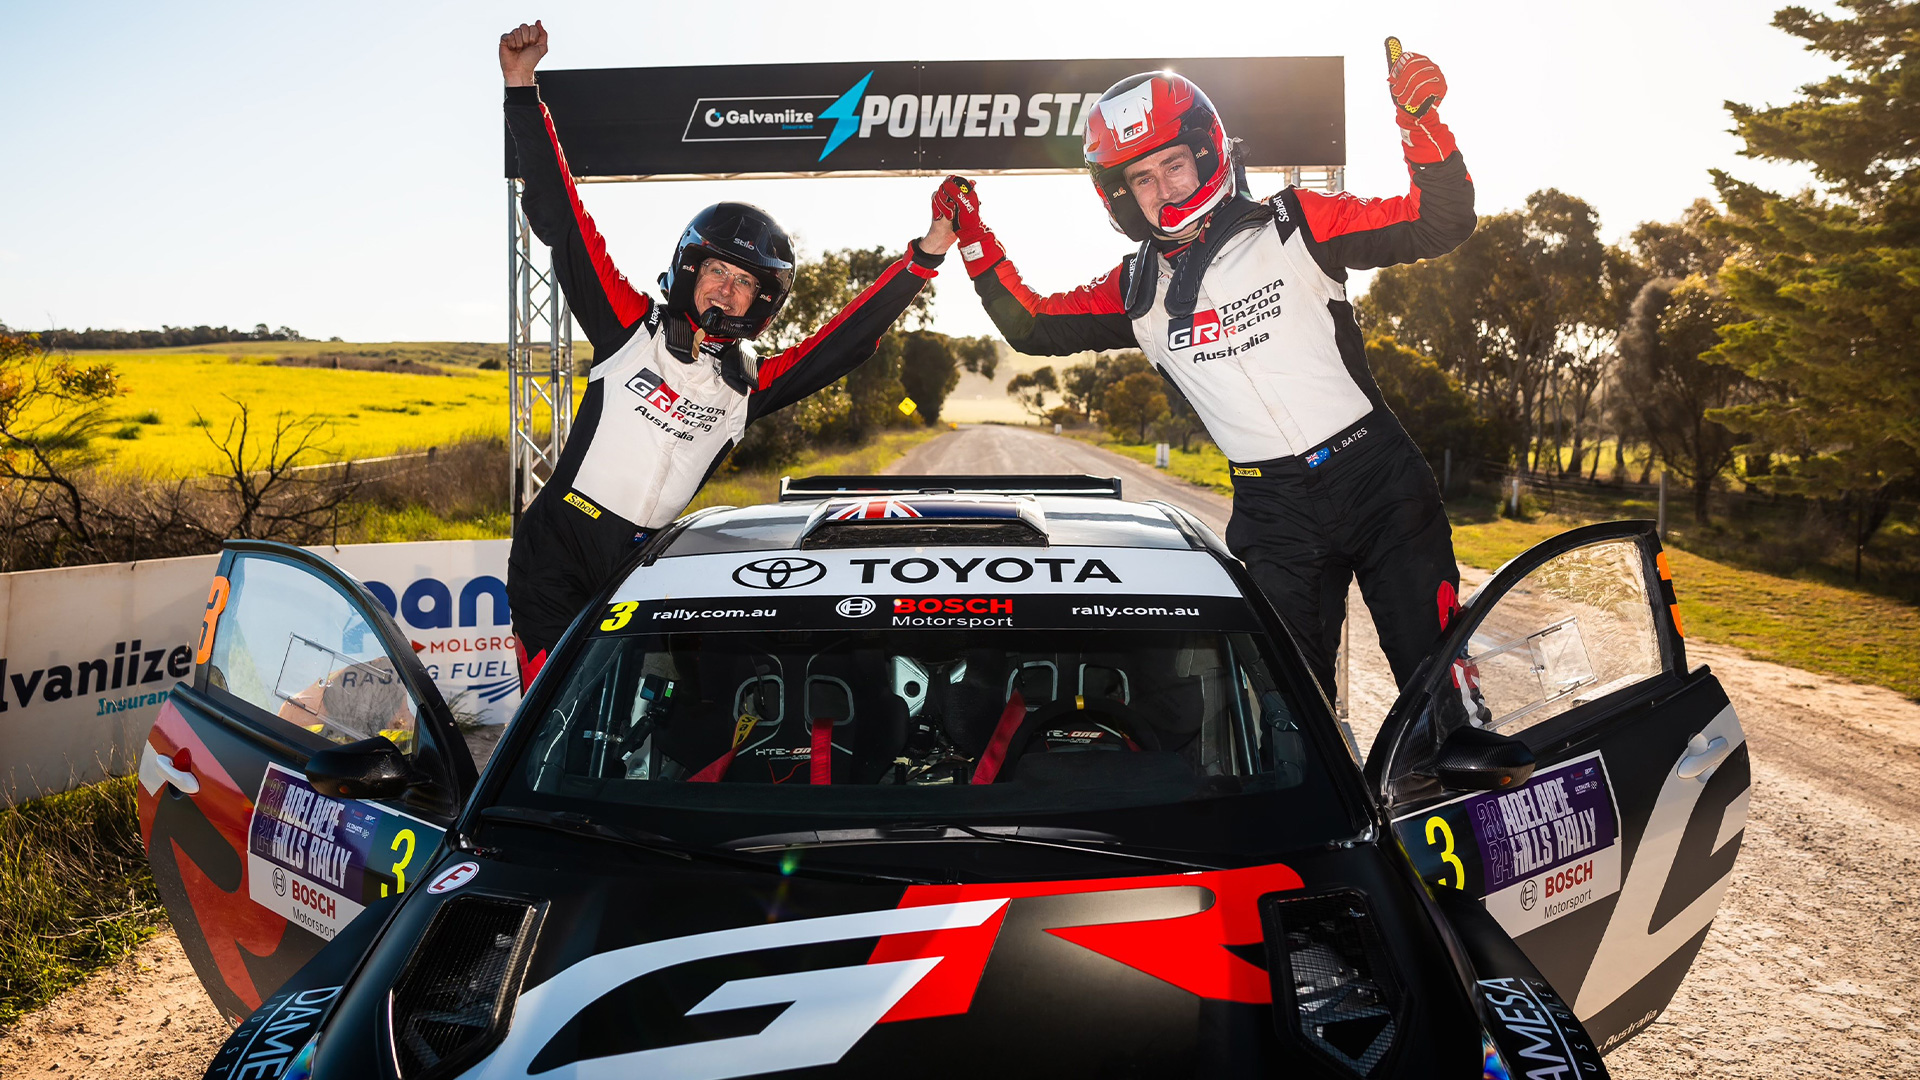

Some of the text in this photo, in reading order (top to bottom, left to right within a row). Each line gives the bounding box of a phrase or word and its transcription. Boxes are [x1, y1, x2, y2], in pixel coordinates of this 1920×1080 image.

[726, 109, 814, 125] Galvaniize
[859, 94, 1021, 138] POWER
[1123, 123, 1143, 140] GR
[1273, 195, 1290, 223] Sabelt
[1219, 279, 1285, 315] TOYOTA
[1222, 293, 1281, 327] GAZOO
[1168, 316, 1220, 350] GR
[1223, 305, 1281, 338] Racing
[1193, 332, 1270, 364] Australia
[627, 374, 675, 412] GR
[683, 397, 726, 416] TOYOTA
[634, 405, 694, 442] Australia
[671, 412, 712, 432] Racing
[676, 405, 718, 423] GAZOO
[1333, 428, 1368, 453] L. BATES
[568, 494, 597, 517] Sabelt
[849, 557, 1123, 584] TOYOTA
[600, 598, 1200, 631] 3 rally.com.au BOSCH rally.com.au
[892, 615, 1013, 628] Motorsport
[451, 660, 512, 679] FUEL
[279, 783, 346, 842] ADELAIDE
[1497, 776, 1574, 836] ADELAIDE
[271, 821, 308, 870] HILLS
[308, 841, 352, 889] RALLY
[1425, 815, 1465, 891] 3
[1509, 823, 1551, 877] HILLS
[1554, 807, 1598, 860] RALLY
[380, 828, 416, 898] 3
[431, 865, 473, 891] E
[1545, 860, 1593, 898] BOSCH
[292, 879, 336, 919] BOSCH
[1544, 888, 1592, 919] Motorsport
[292, 905, 337, 939] Motorsport
[1603, 1008, 1658, 1051] Australia
